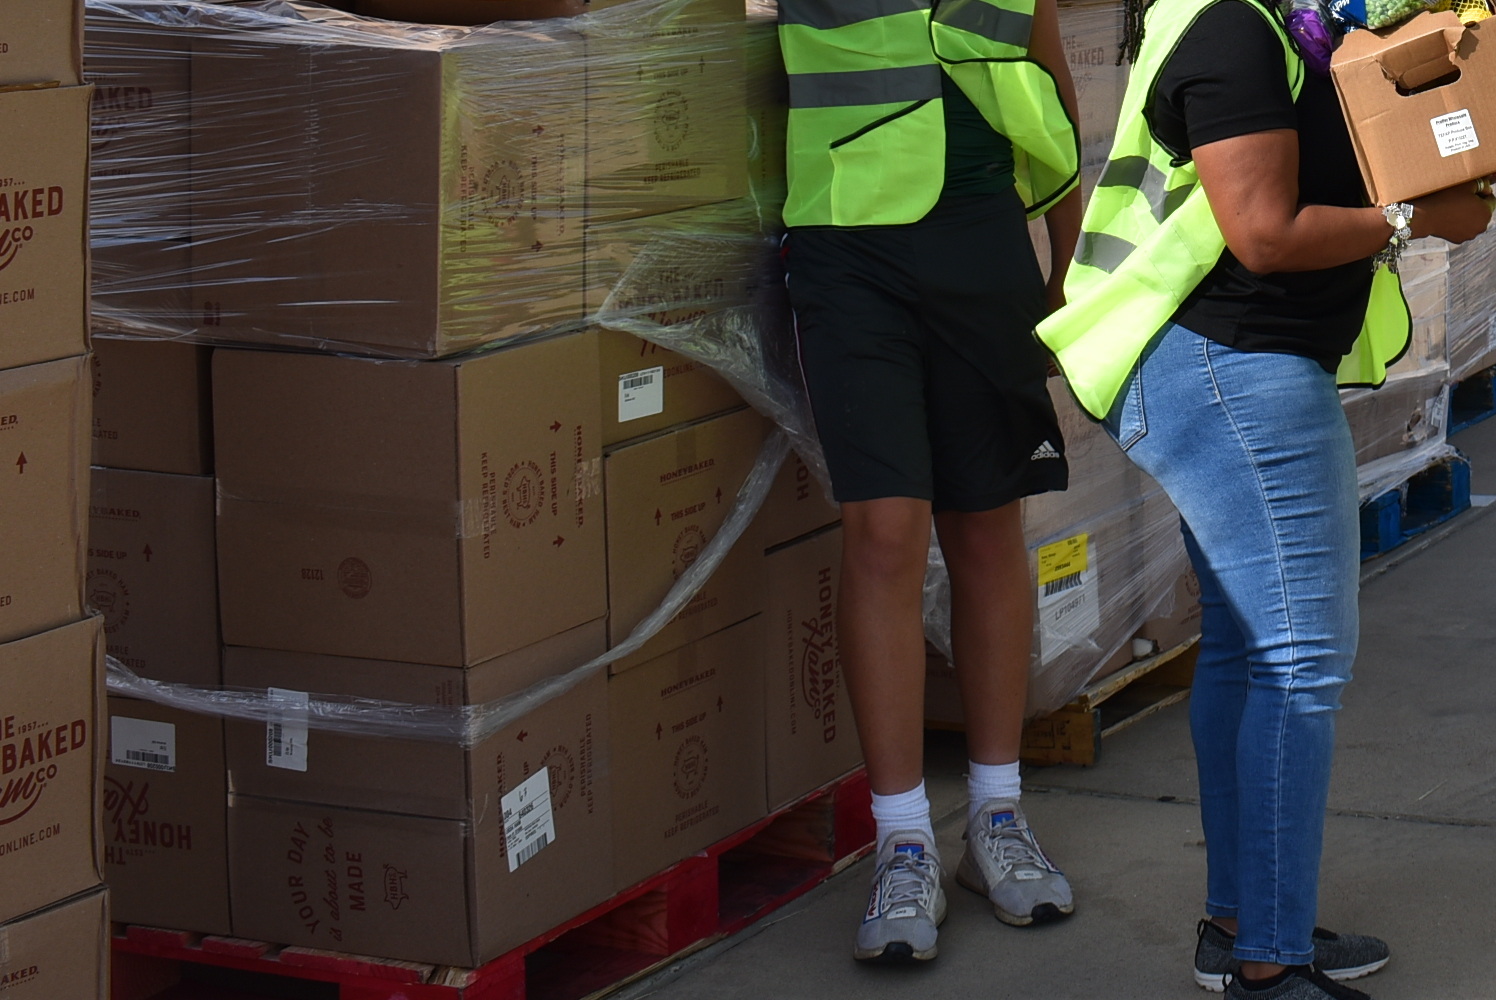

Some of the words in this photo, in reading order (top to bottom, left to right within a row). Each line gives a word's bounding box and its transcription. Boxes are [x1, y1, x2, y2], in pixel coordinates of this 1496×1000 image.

[0, 186, 63, 222] AKED
[659, 458, 715, 483] HONEYBAKED
[1030, 451, 1060, 461] adidas
[551, 502, 558, 517] UP
[671, 508, 684, 522] THIS
[684, 505, 697, 517] SIDE
[697, 502, 706, 512] UP
[818, 566, 834, 651] HONEY
[660, 667, 716, 698] HONEYBAKED
[820, 659, 836, 744] BAKED
[671, 721, 685, 734] THIS
[685, 715, 698, 728] SIDE
[698, 711, 707, 722] UP
[1, 719, 86, 775] BAKED
[36, 764, 57, 783] CO
[115, 819, 192, 850] HONEY
[288, 821, 311, 864] DAY
[317, 816, 334, 838] be
[323, 843, 336, 864] to
[322, 869, 340, 921] about
[346, 851, 366, 911] MADE
[288, 876, 321, 935] YOUR
[329, 927, 342, 942] is
